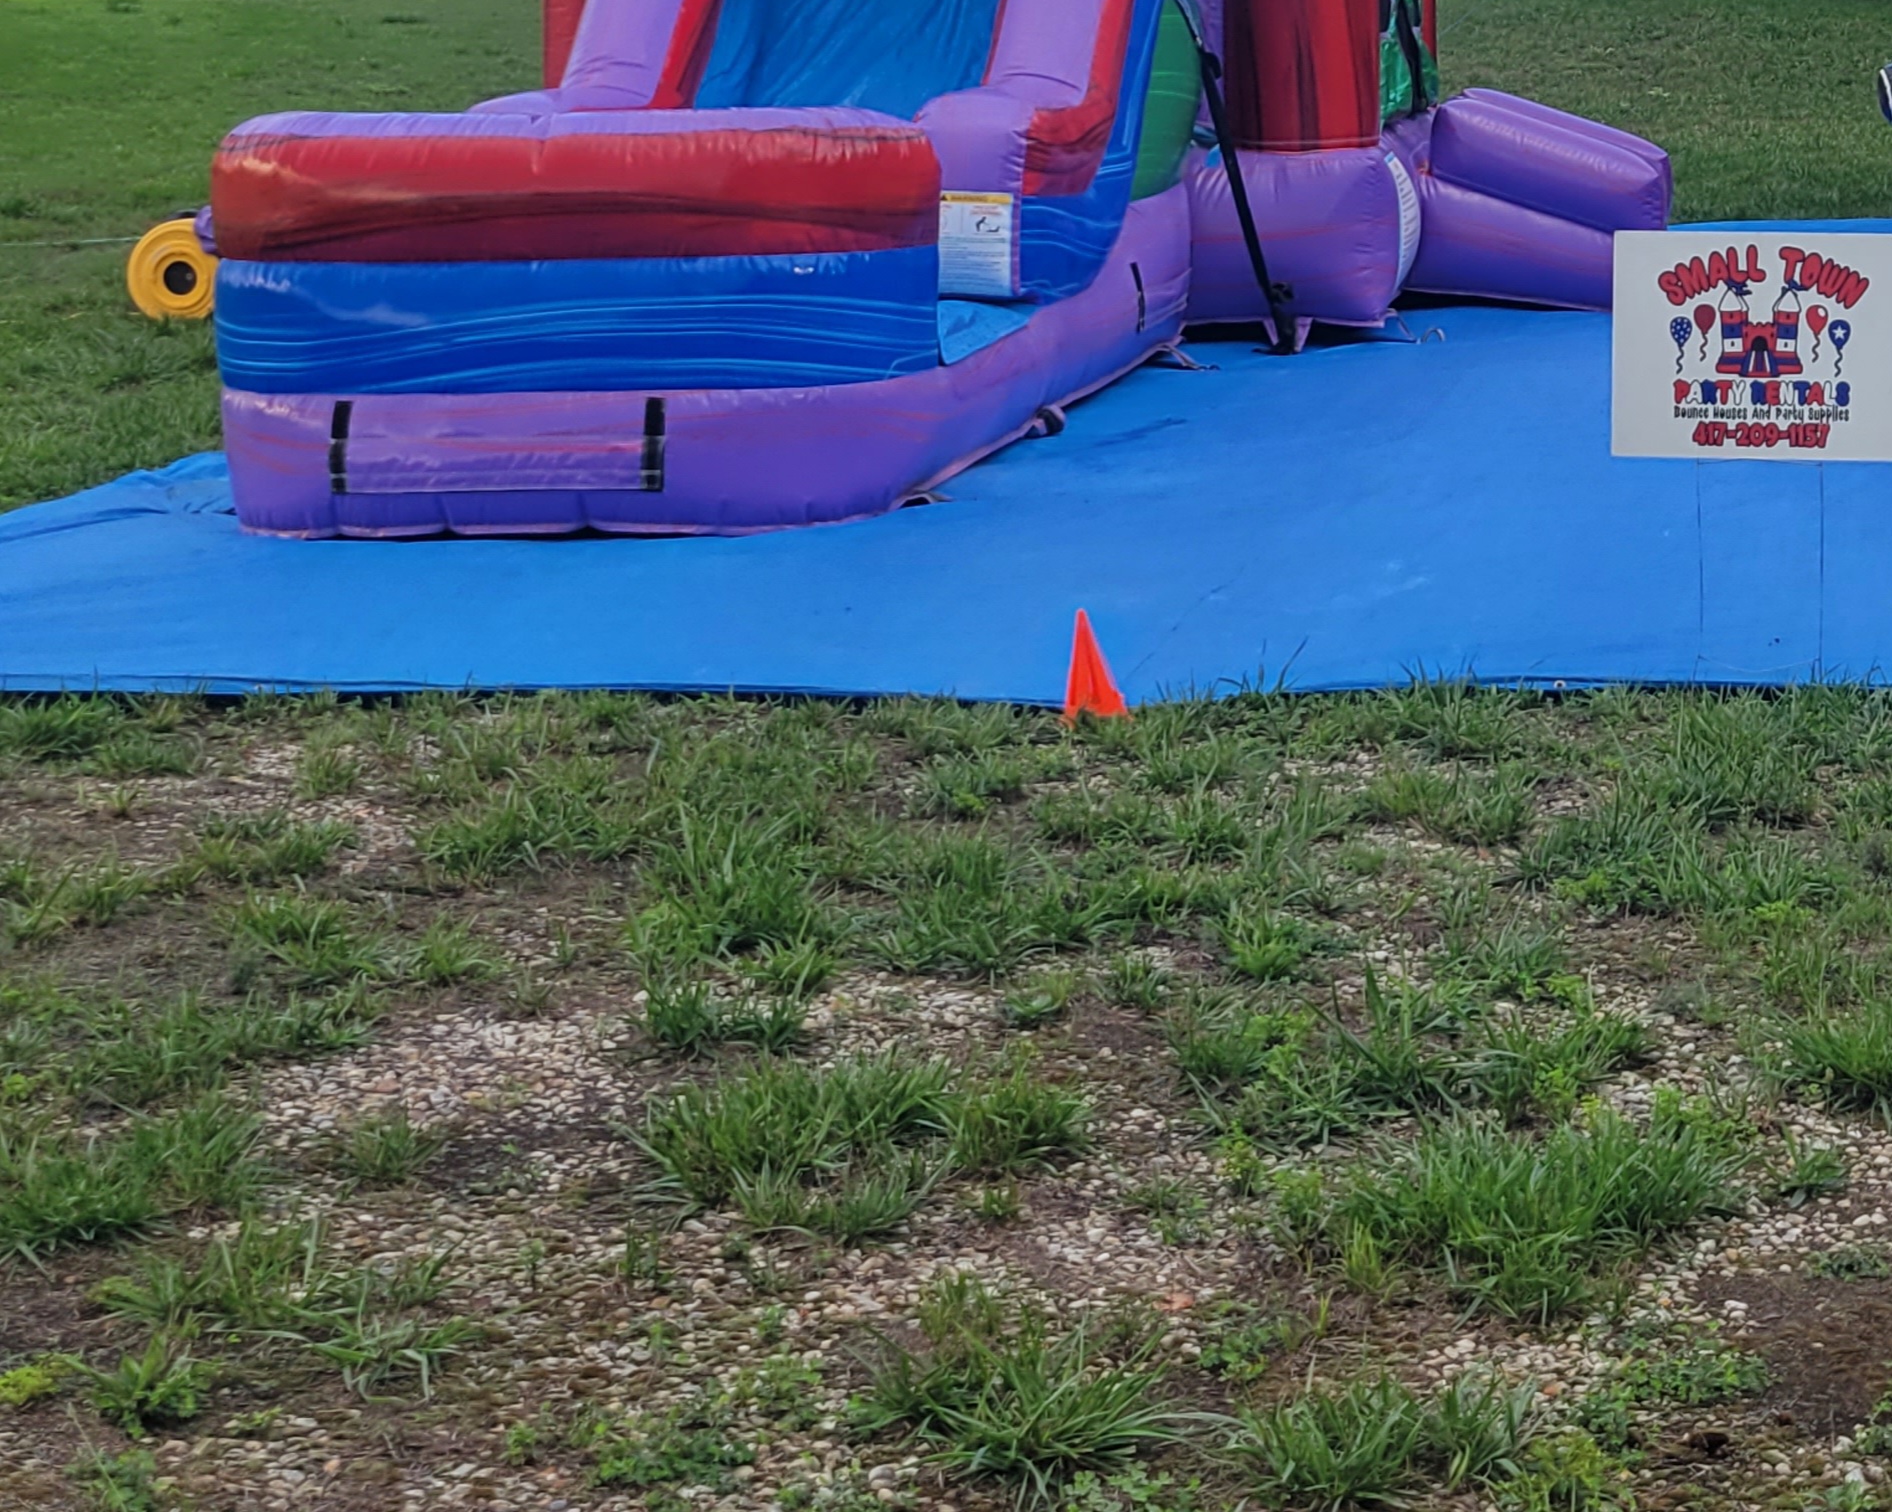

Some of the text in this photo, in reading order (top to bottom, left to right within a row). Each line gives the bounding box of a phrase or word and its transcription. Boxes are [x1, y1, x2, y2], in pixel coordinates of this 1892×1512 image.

[1658, 244, 1869, 309] SMALL TOWN
[1674, 379, 1851, 406] PARTY RENTALS
[1674, 406, 1850, 423] Bounce Houses And Party Supplies
[1693, 422, 1830, 448] 417-209-1157
